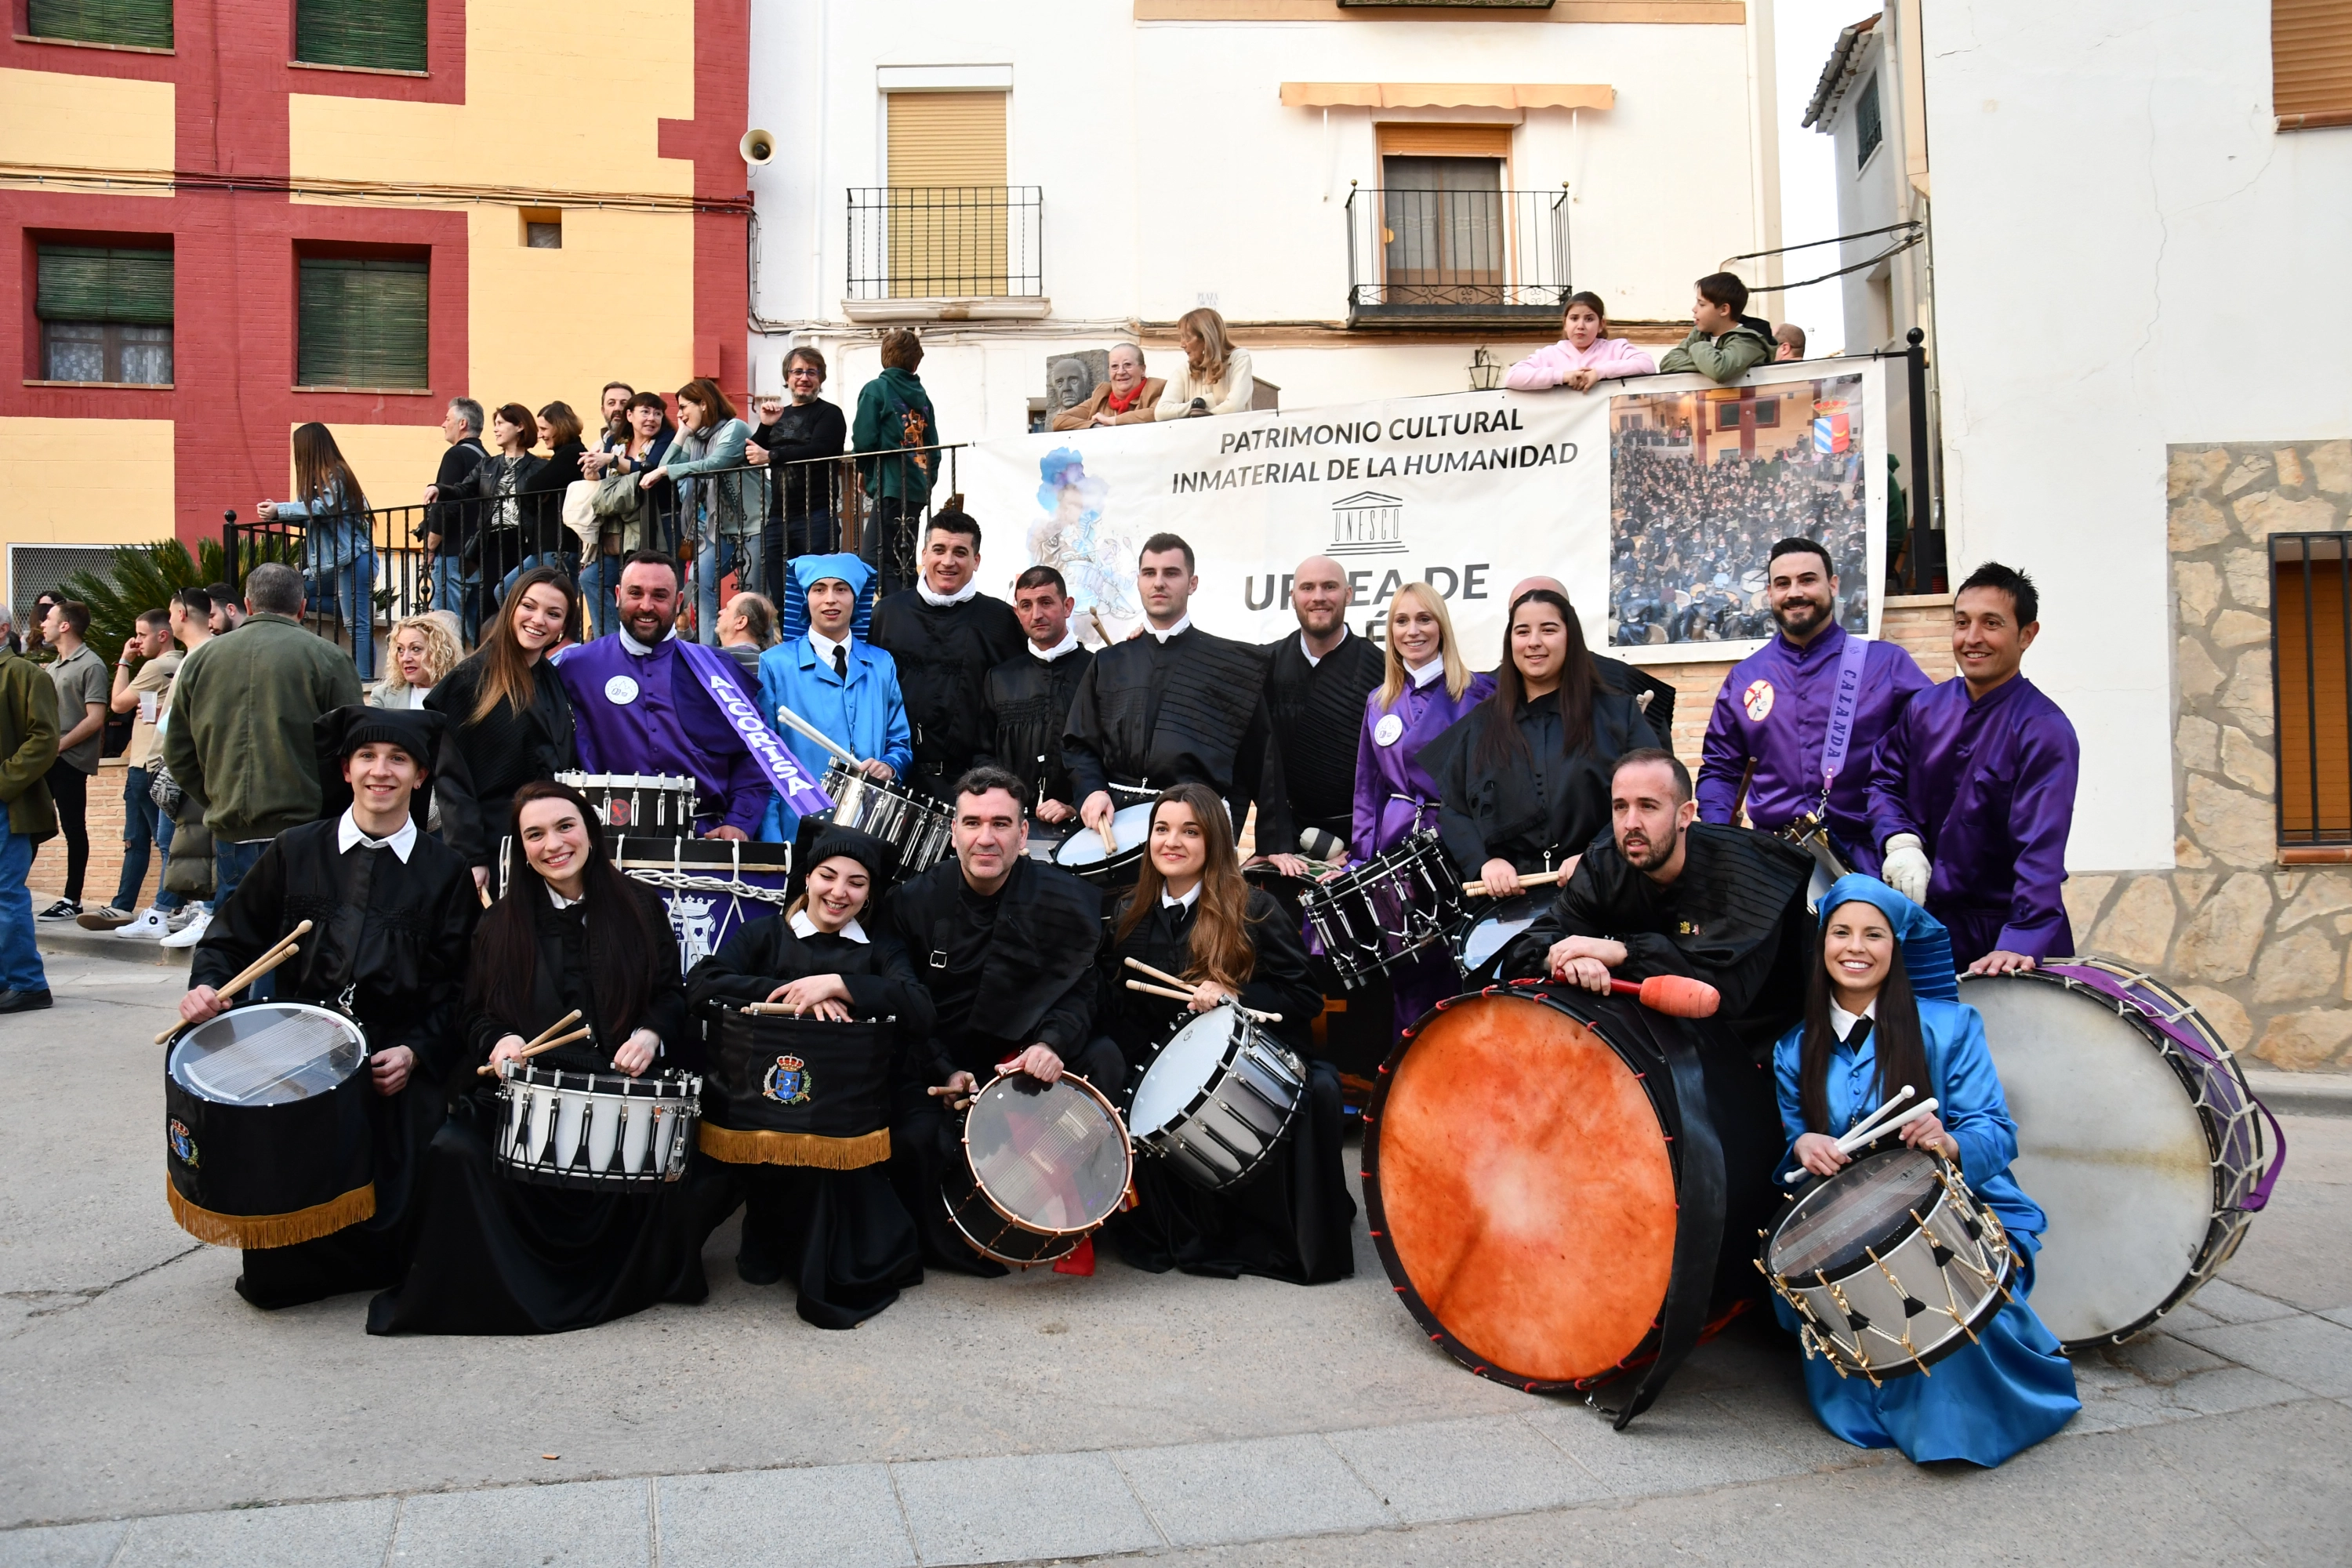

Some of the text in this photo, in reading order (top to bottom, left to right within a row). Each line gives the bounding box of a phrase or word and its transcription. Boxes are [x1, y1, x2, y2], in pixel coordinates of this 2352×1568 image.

[1220, 408, 1523, 454] PATRIMONIO CULTURAL
[1172, 443, 1578, 494] INMATERIAL DE LA HUMANIDAD
[1334, 508, 1399, 542] UNESCO
[1424, 564, 1490, 601] DE
[710, 675, 815, 797] ALCORISA
[1828, 670, 1857, 758] CALANDA
